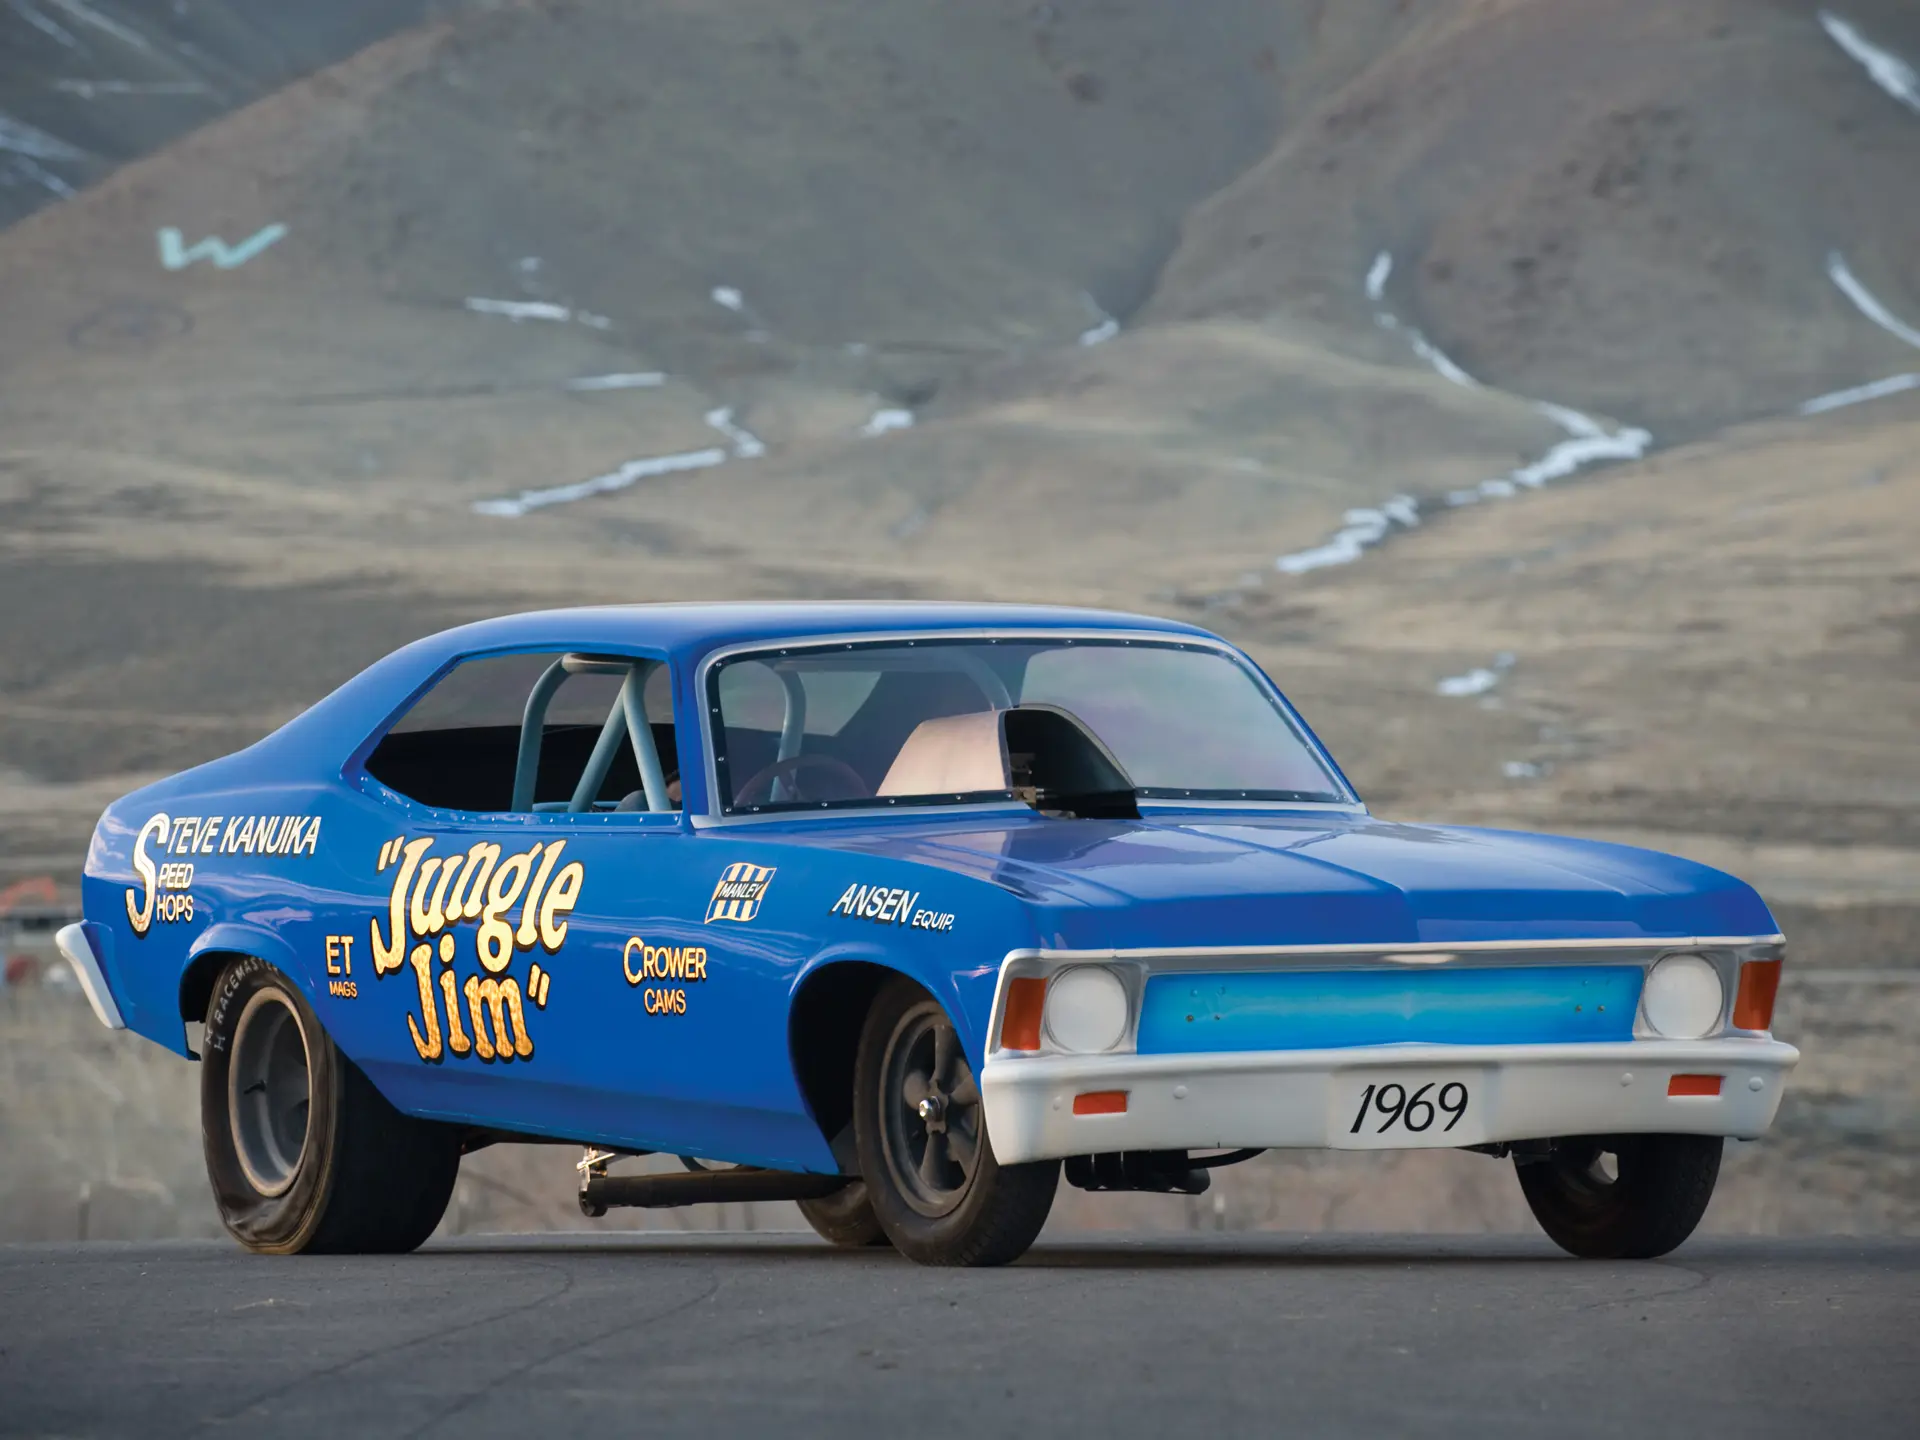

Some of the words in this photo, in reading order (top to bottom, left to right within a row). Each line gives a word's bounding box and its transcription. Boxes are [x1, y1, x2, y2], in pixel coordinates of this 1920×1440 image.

[219, 815, 322, 855] KANUIKA
[717, 882, 765, 899] MANLEY
[831, 882, 920, 923] ANSEN
[912, 909, 955, 931] EQUIP.
[325, 934, 355, 975] ET
[623, 936, 708, 984] CROWER
[328, 980, 358, 998] MAGS
[644, 989, 687, 1015] CAMS
[1349, 1081, 1469, 1134] 1969
